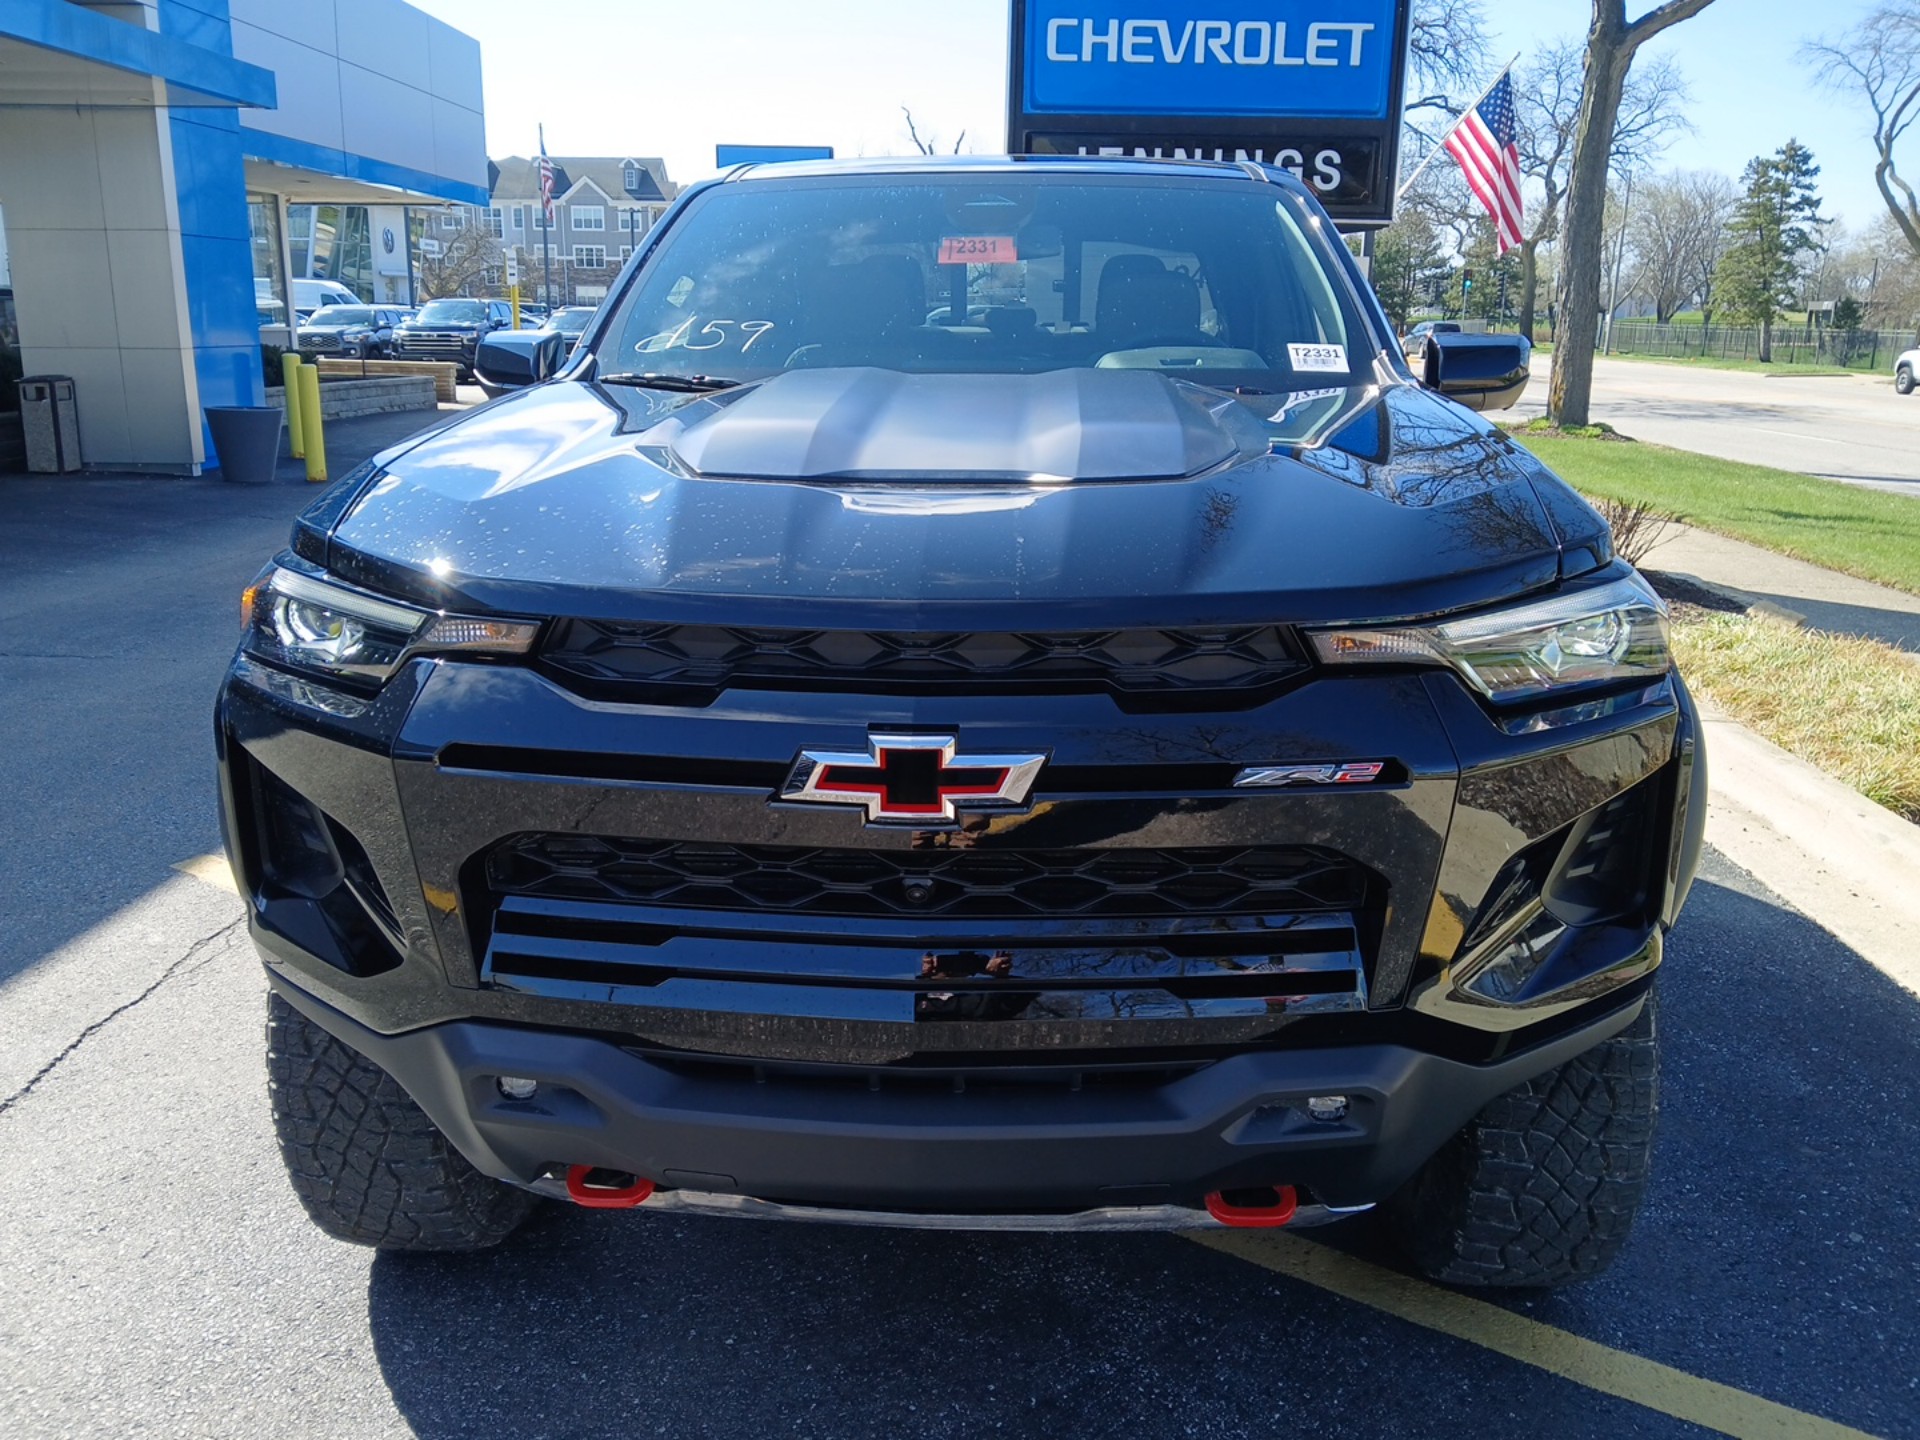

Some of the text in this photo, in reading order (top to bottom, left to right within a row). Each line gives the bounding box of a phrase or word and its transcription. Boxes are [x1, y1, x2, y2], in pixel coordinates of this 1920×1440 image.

[1046, 18, 1375, 67] CHEVROLET
[1292, 347, 1341, 359] T2331
[1233, 762, 1384, 788] ZR2
